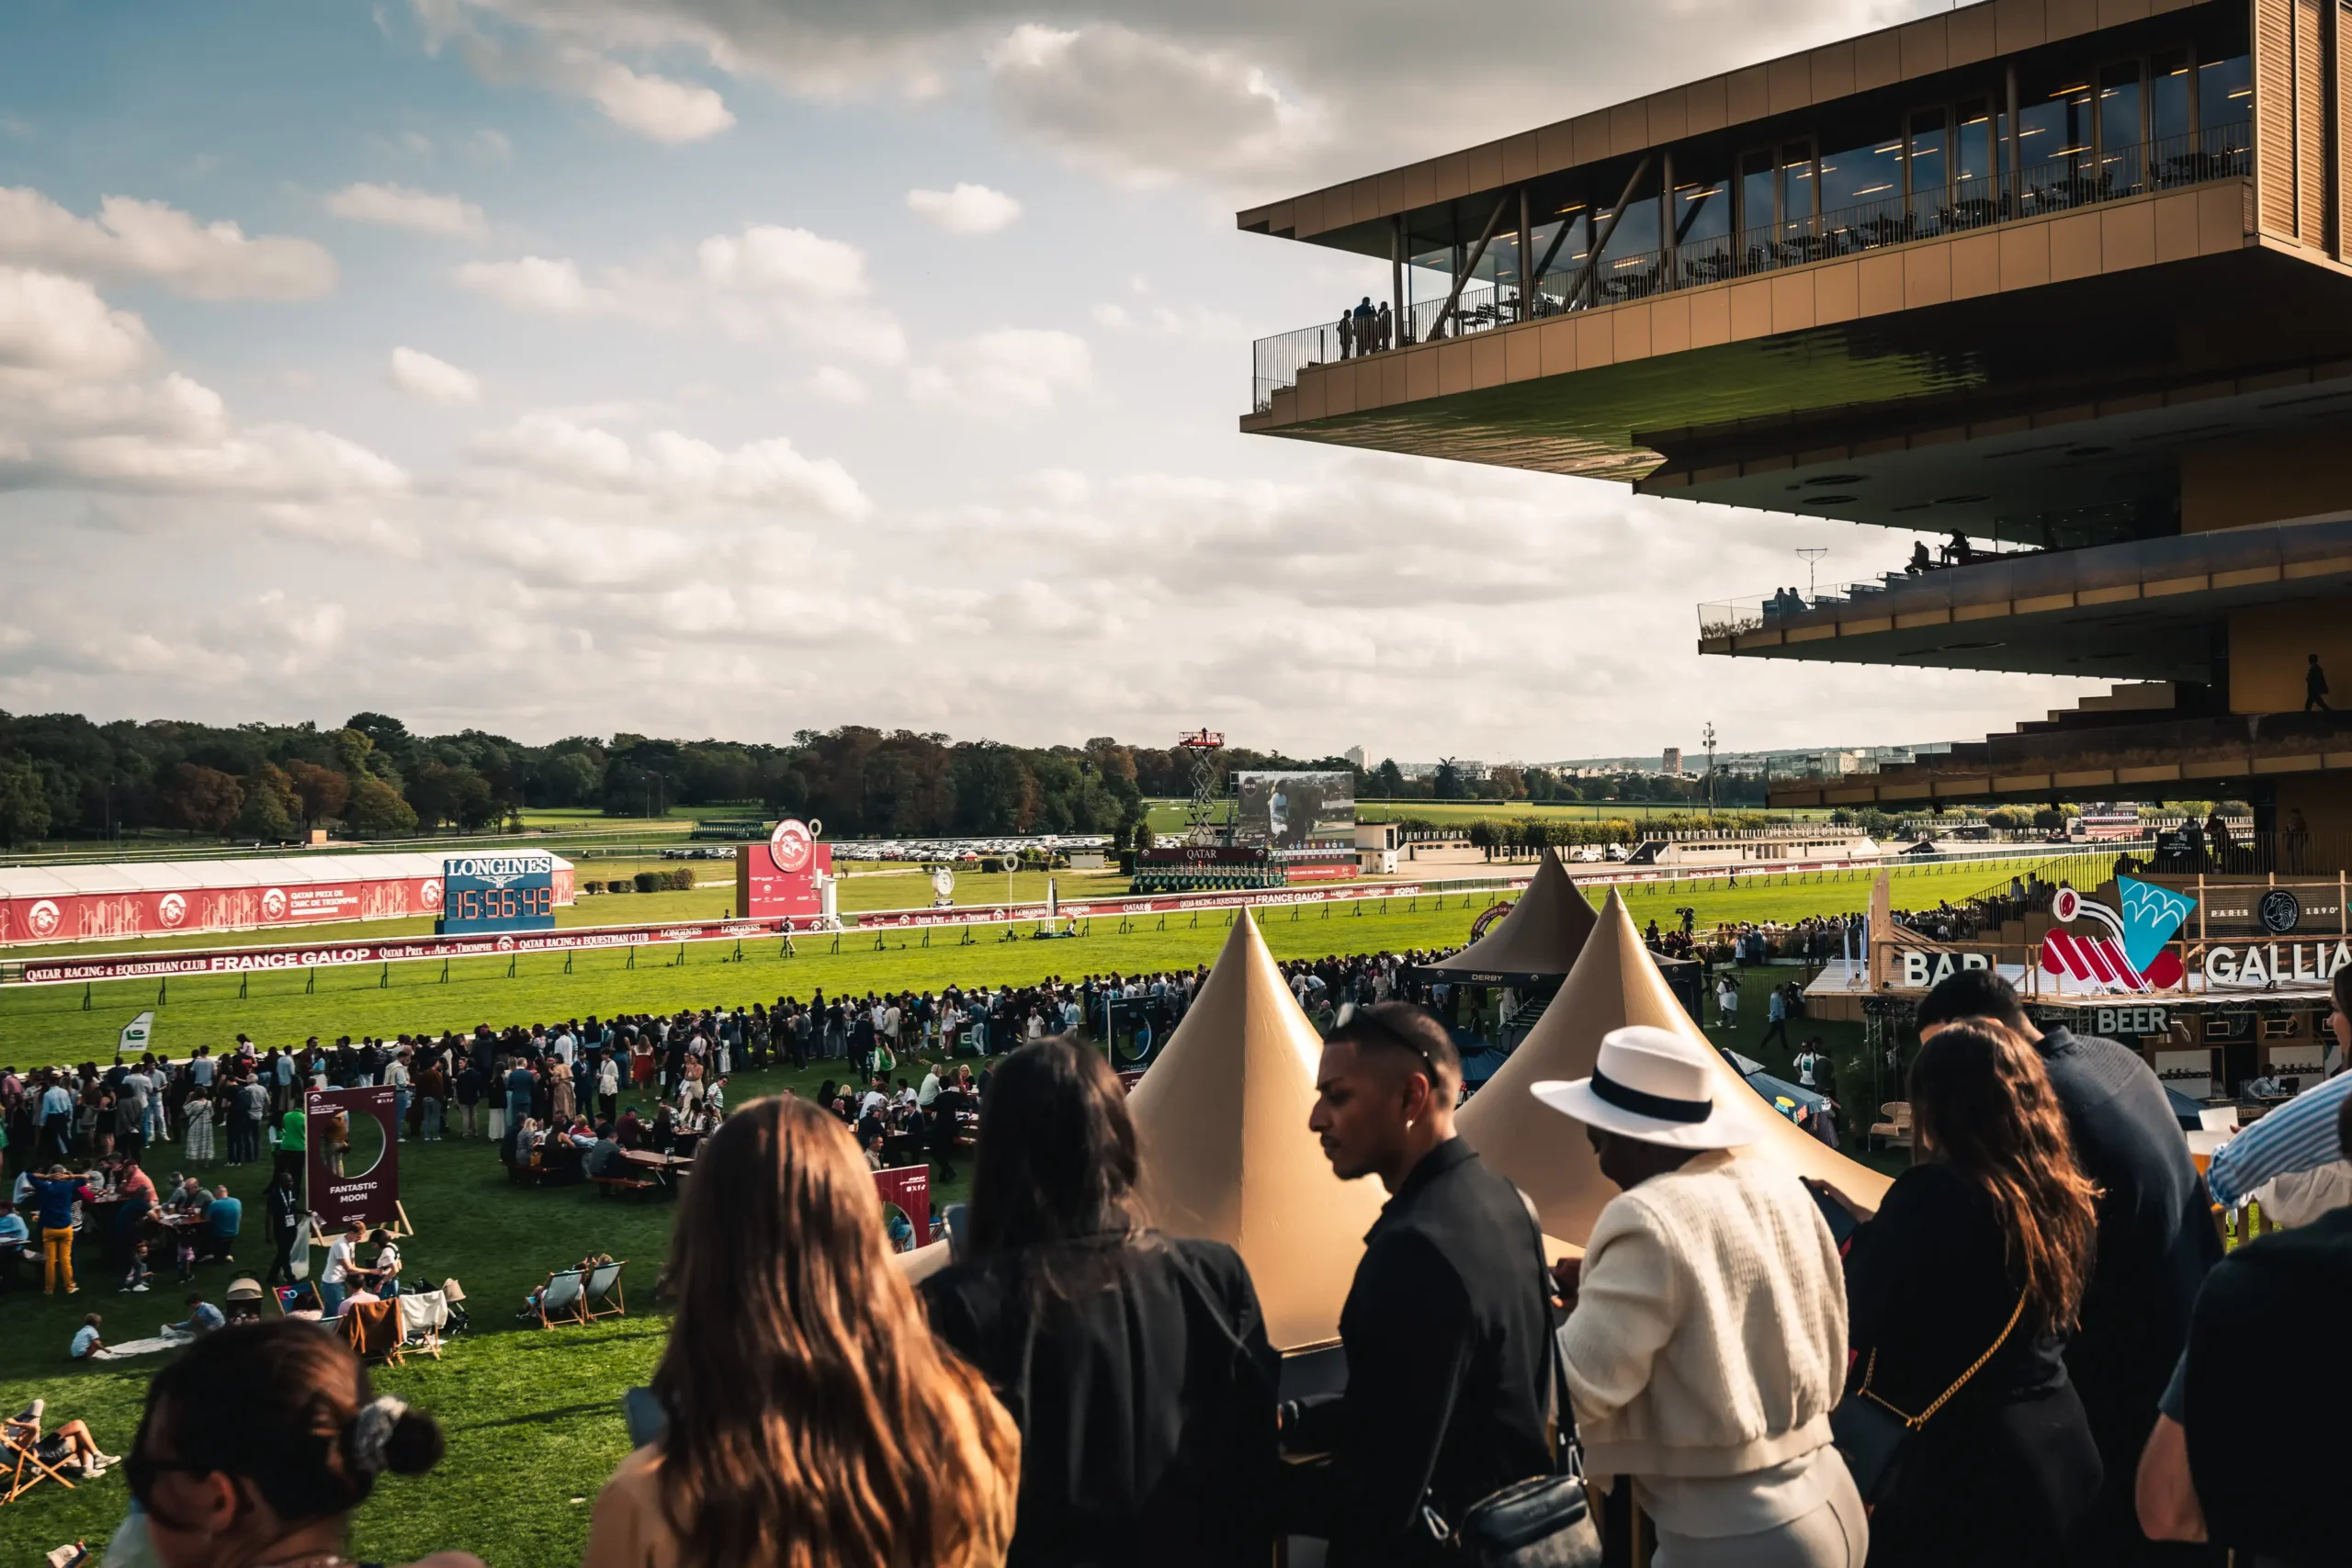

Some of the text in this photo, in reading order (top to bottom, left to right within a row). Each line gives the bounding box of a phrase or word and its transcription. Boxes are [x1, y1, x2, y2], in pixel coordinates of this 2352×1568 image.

[1187, 849, 1216, 859] QATAR
[447, 858, 551, 875] LONGINES
[458, 887, 552, 919] 15:56:49
[1256, 894, 1293, 904] FRANCE
[1295, 892, 1325, 901] GALOP
[1394, 886, 1419, 896] #QPAT
[1123, 903, 1145, 912] QATAR
[27, 969, 62, 981] QATAR
[64, 966, 104, 977] RACING
[107, 967, 113, 976] &
[116, 962, 179, 976] EQUESTRIAN
[180, 960, 207, 971] CLUB
[211, 953, 298, 970] FRANCE
[301, 948, 370, 964] GALOP
[519, 940, 544, 950] QATAR
[547, 937, 575, 947] RACING
[583, 934, 628, 945] EQUESTRIAN
[629, 933, 650, 942] CLUB
[661, 928, 702, 937] LONGINES
[721, 924, 760, 933] LONGINES
[2205, 942, 2352, 984] GALLIA
[2098, 1007, 2168, 1033] BEER
[330, 1181, 378, 1194] FANTASTIC
[340, 1193, 368, 1202] MOON
